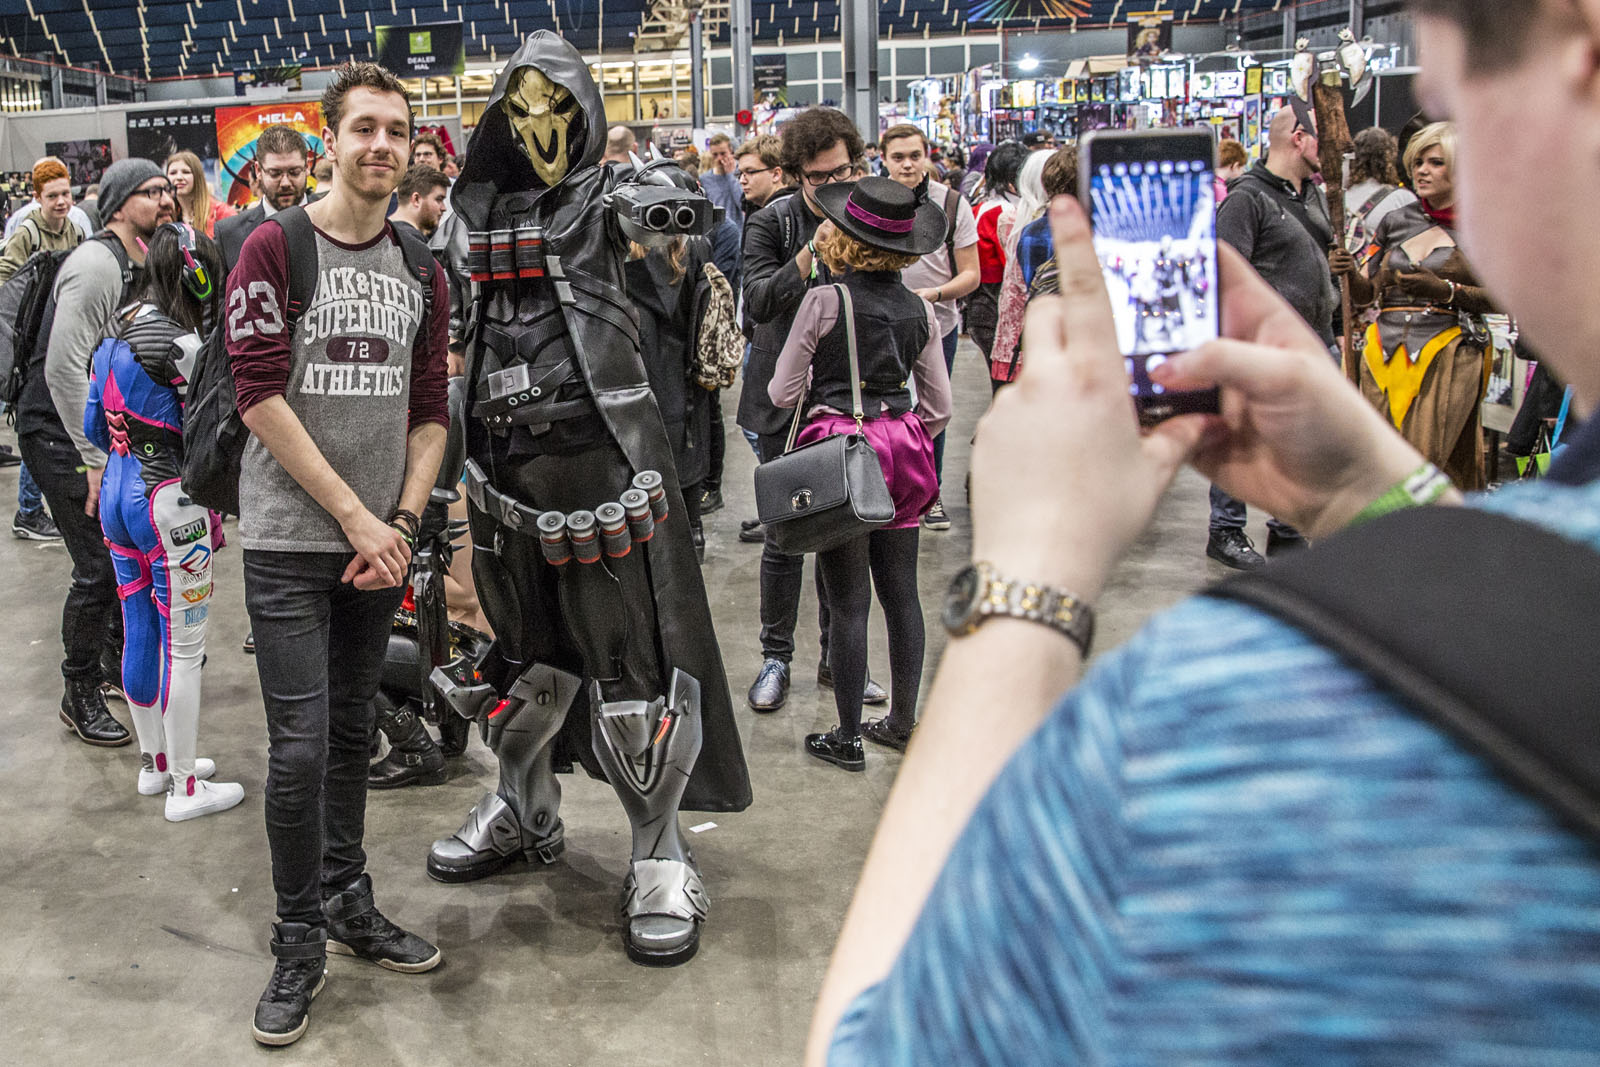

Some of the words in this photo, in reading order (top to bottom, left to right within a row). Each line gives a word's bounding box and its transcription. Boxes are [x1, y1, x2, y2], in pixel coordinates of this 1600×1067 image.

[407, 56, 436, 65] DEALER
[258, 111, 305, 124] HELA
[229, 281, 285, 342] 23
[311, 267, 423, 327] ACK&FIELD
[304, 299, 411, 347] SUPERDRY
[347, 341, 370, 359] 72
[300, 363, 404, 396] ATHLETICS
